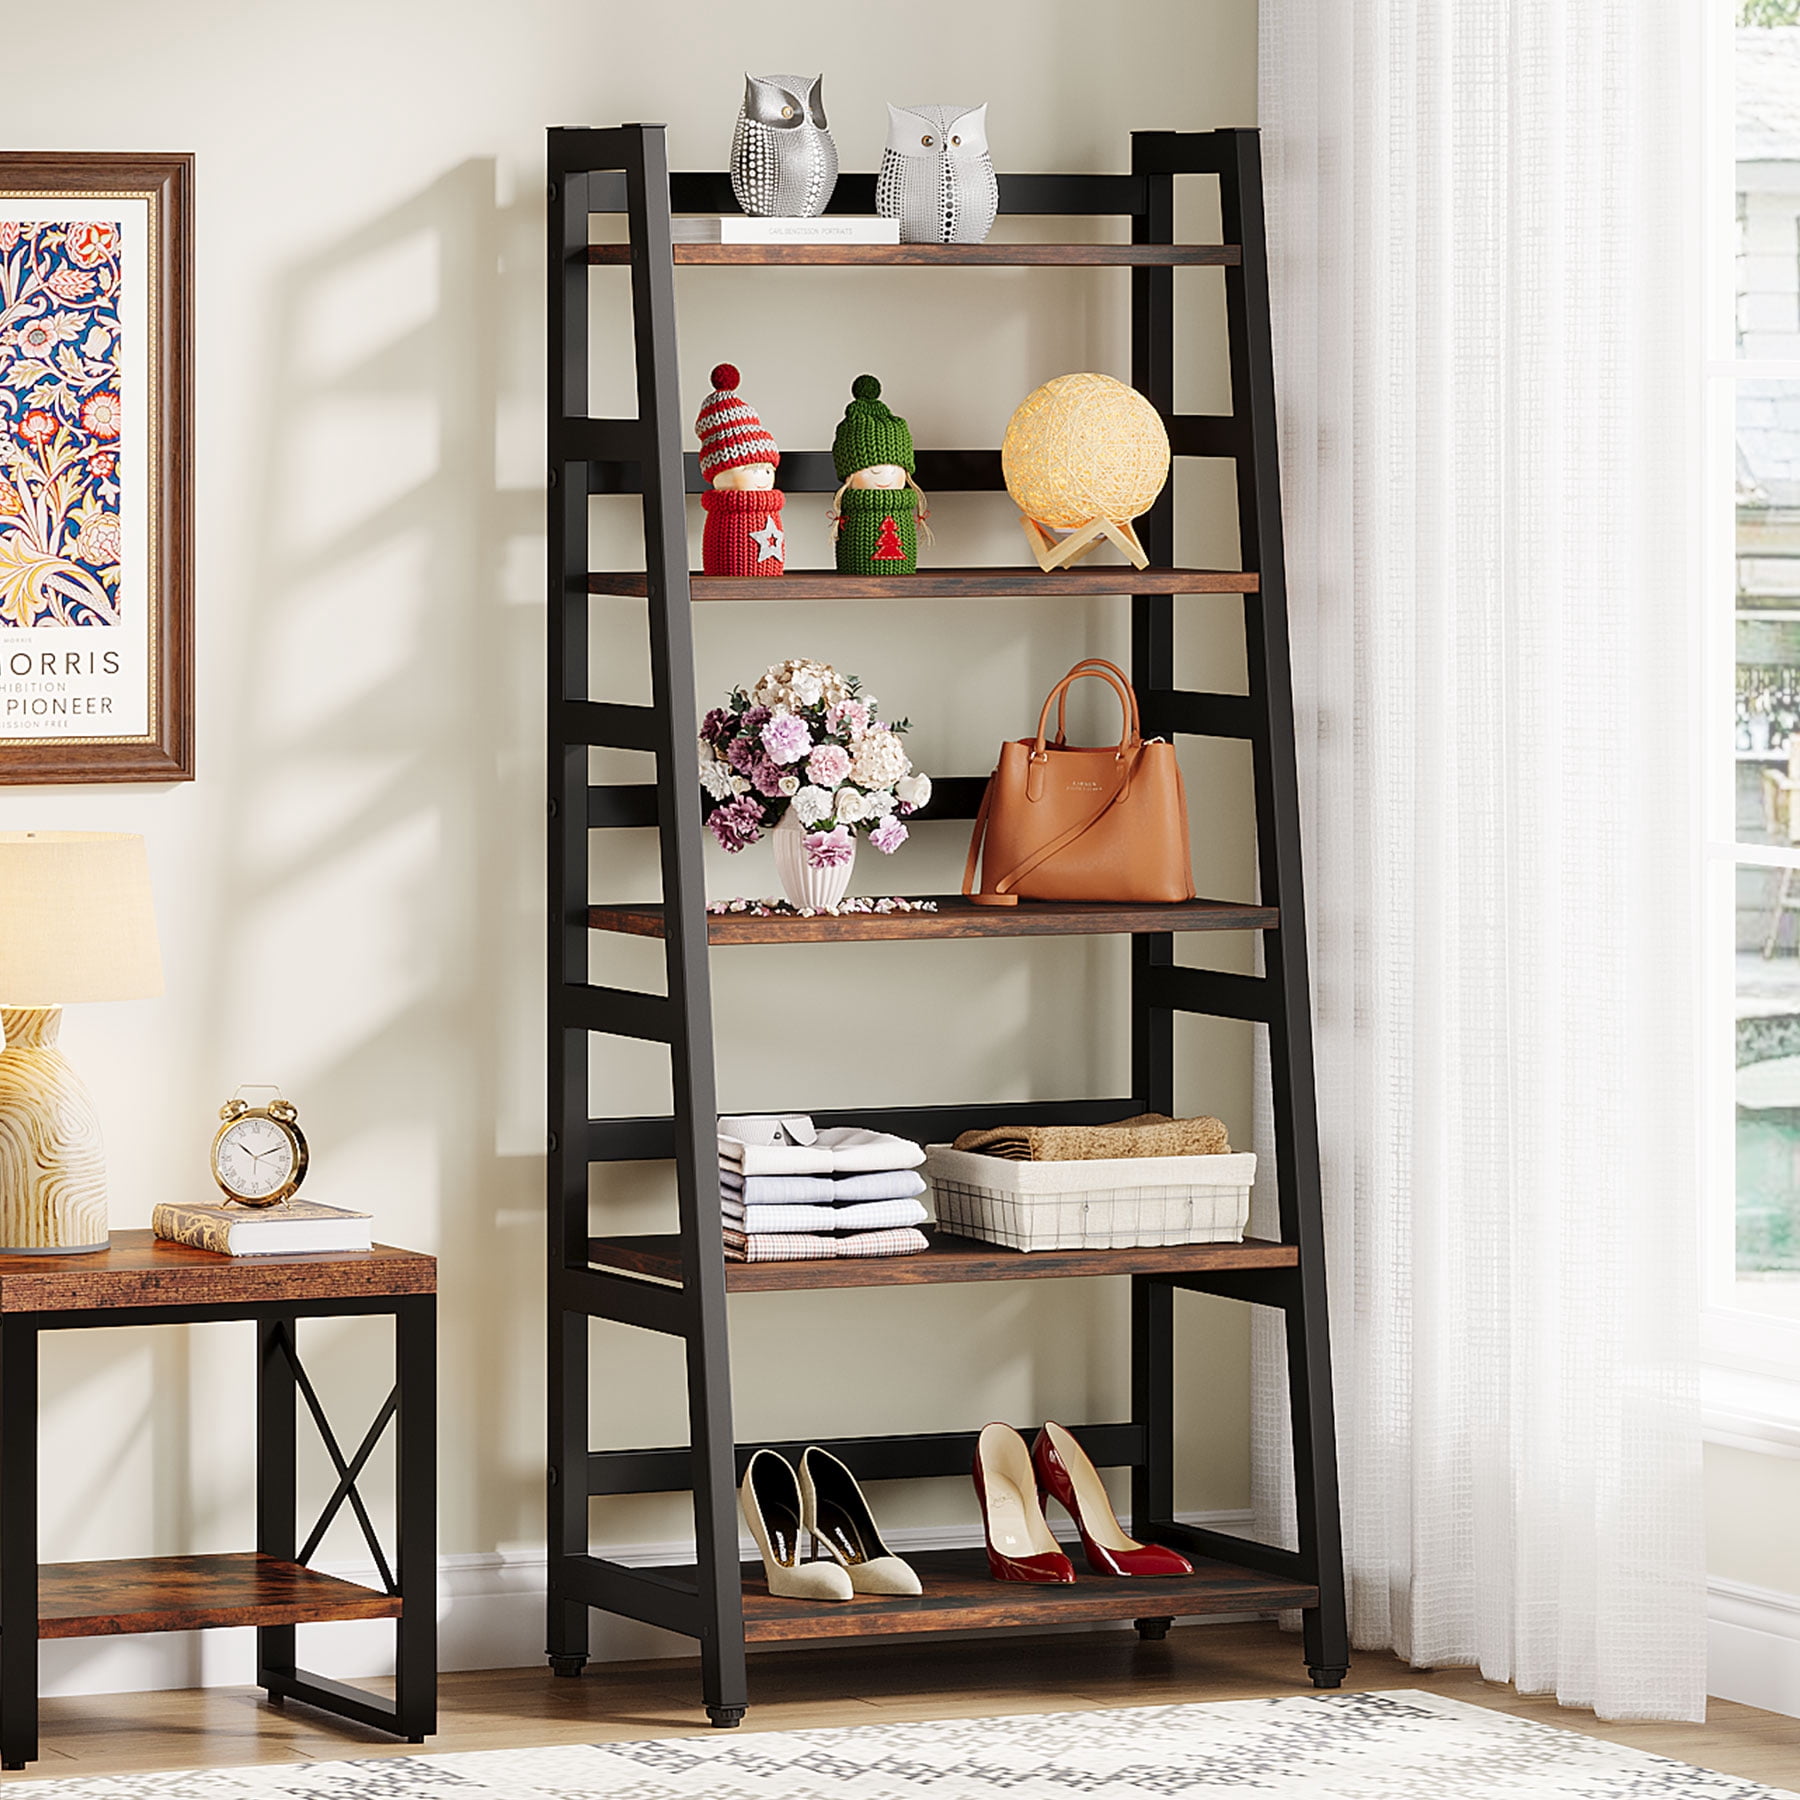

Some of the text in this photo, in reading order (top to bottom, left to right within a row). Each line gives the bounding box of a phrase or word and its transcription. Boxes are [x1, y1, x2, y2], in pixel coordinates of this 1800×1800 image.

[0, 651, 120, 676] ORRIS
[7, 697, 112, 715] PIONEER
[44, 720, 68, 728] FREE
